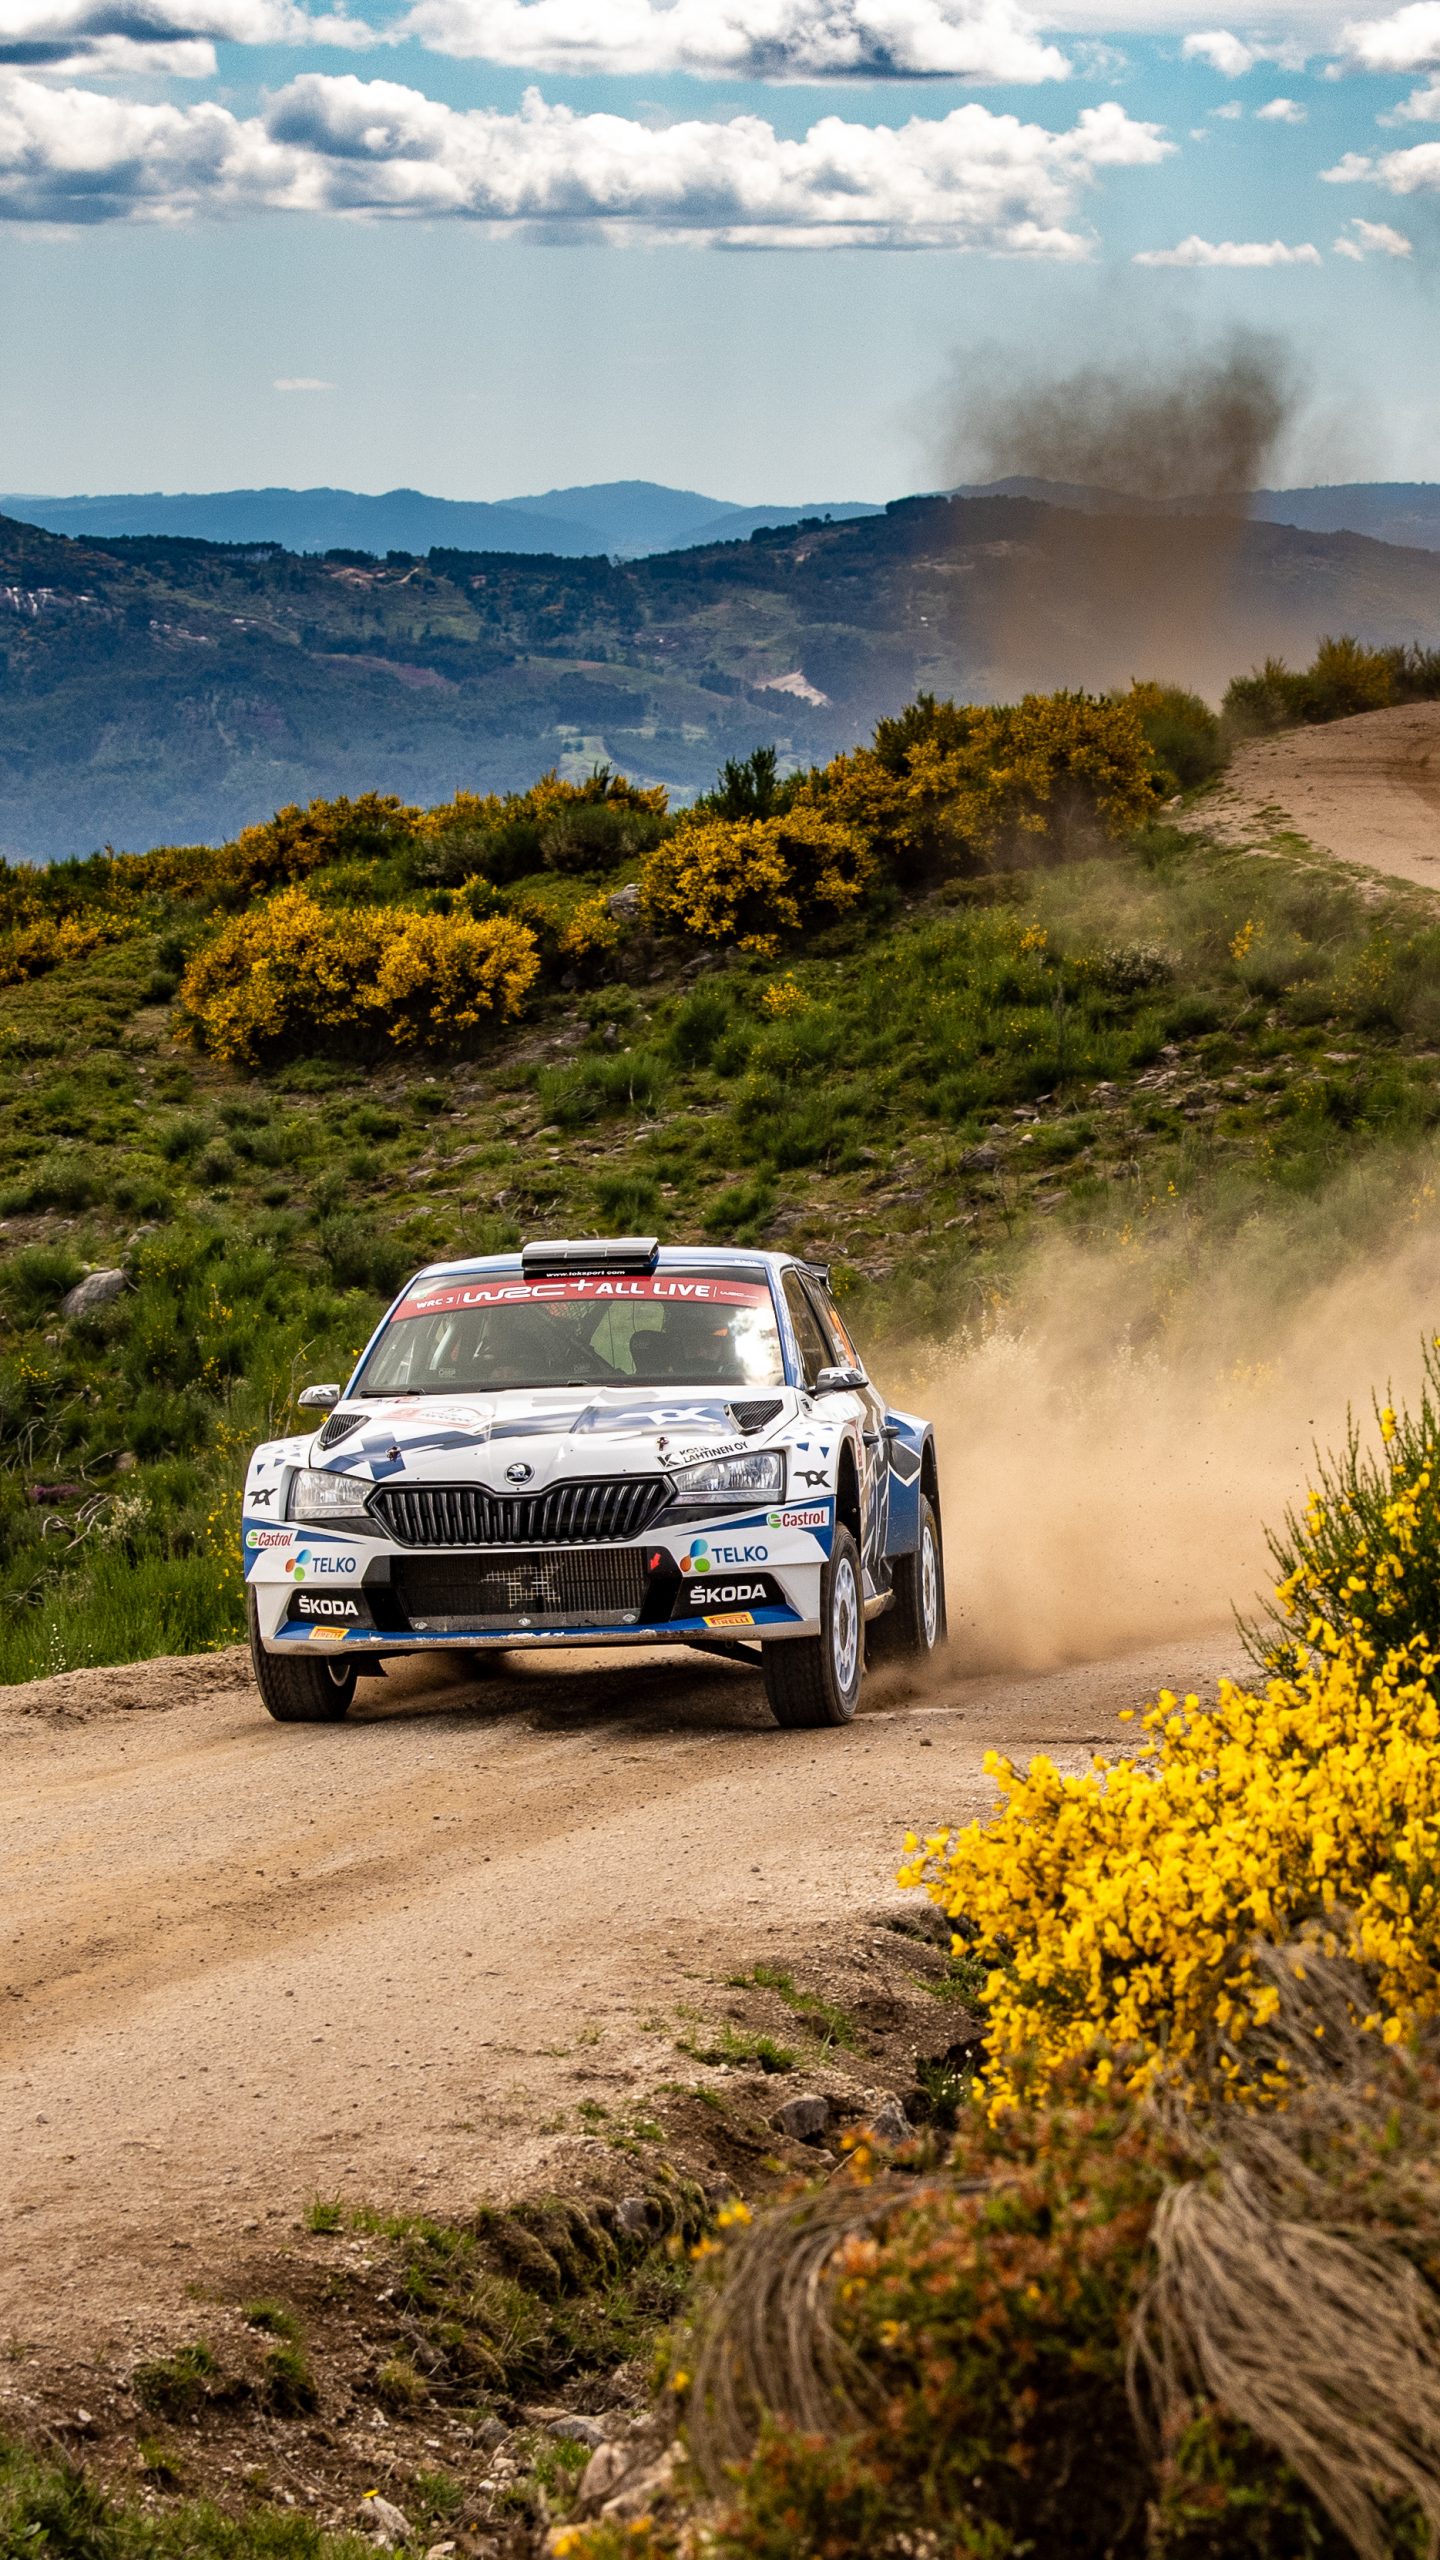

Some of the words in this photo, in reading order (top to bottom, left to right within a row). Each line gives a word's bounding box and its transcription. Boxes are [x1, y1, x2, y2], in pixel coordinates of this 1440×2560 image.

[546, 1270, 625, 1278] www.toksportcom
[416, 1298, 443, 1309] WRC
[445, 1296, 454, 1304] 3
[595, 1282, 645, 1294] ALL
[653, 1283, 711, 1297] LIVE
[683, 1445, 734, 1463] LAHTINEN
[734, 1441, 749, 1451] OY
[782, 1510, 825, 1527] Castrol
[258, 1532, 293, 1547] Castrol
[711, 1545, 768, 1563] TELKO
[312, 1557, 357, 1573] TELKO
[690, 1584, 767, 1605] ŠKODA
[298, 1595, 359, 1616] ŠKODA
